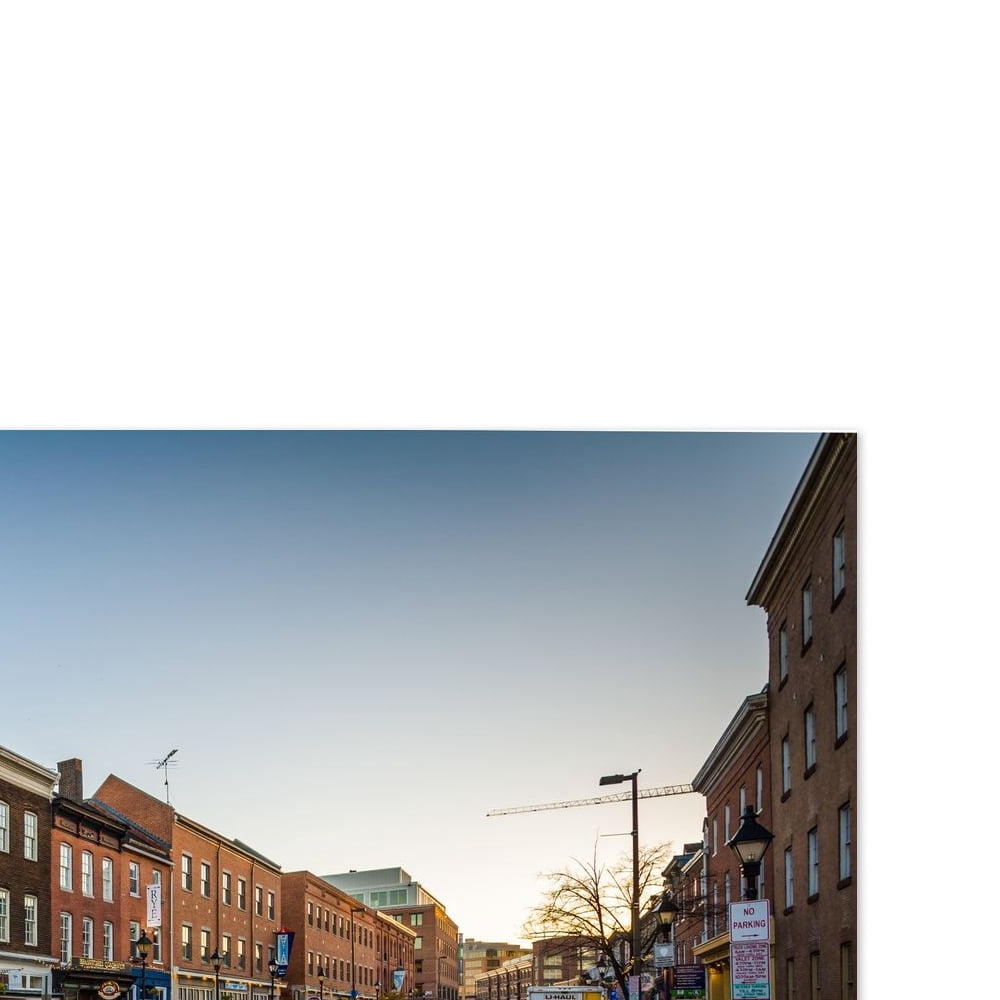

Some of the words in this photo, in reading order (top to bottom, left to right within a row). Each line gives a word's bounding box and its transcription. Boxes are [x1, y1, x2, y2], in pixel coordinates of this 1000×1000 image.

[150, 889, 158, 919] RYE
[743, 907, 755, 916] NO
[733, 919, 766, 930] PARKING
